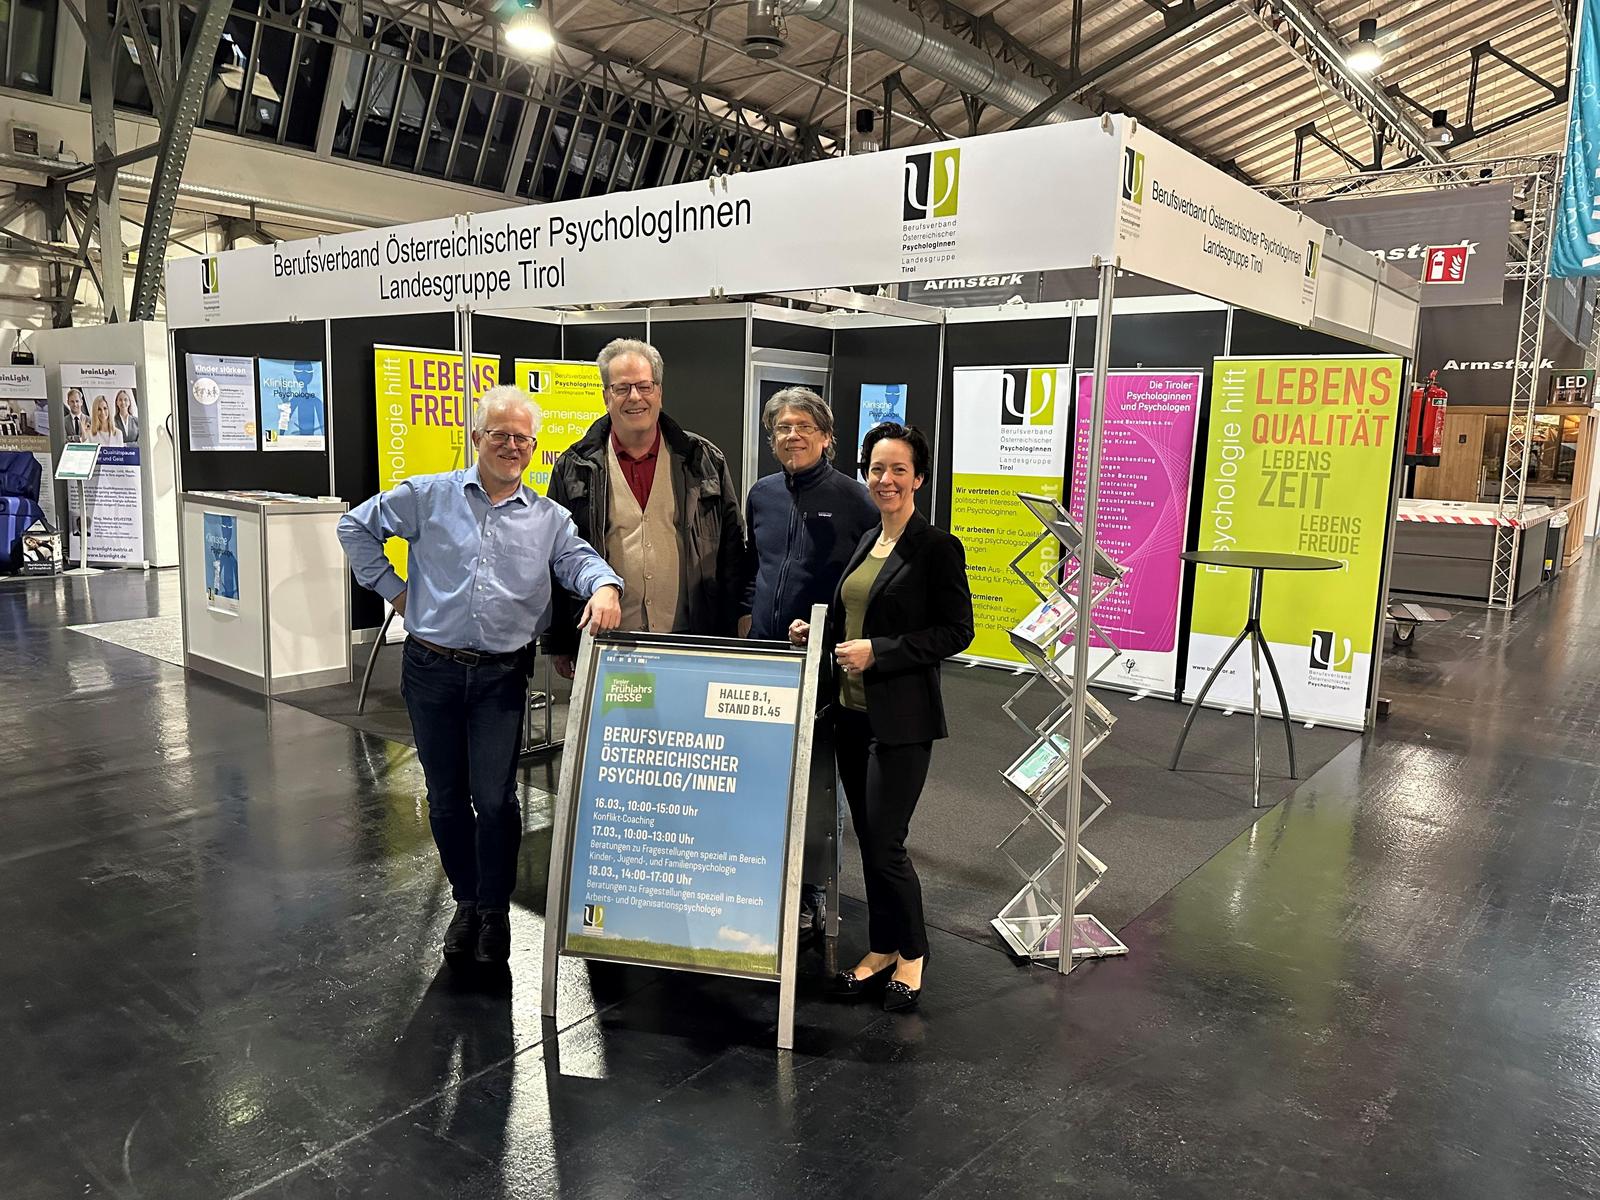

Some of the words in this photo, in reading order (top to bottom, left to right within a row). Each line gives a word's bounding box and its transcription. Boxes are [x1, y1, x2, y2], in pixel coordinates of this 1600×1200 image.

[903, 220, 957, 232] Berufsverband
[1152, 180, 1207, 223] Berufsverband
[1208, 204, 1260, 246] Österreichischer
[1260, 231, 1301, 265] PsychologInnen
[274, 241, 380, 278] Berufsverband
[385, 223, 541, 267] Österreichischer
[549, 198, 752, 254] PsychologInnen
[902, 230, 956, 241] Österreichischer
[901, 254, 956, 264] Landesgruppe
[1203, 234, 1249, 270] Landesgruppe
[1250, 253, 1264, 274] Tirol
[379, 268, 511, 302] Landesgruppe
[519, 258, 566, 290] Tirol
[923, 273, 1024, 291] Armstark
[80, 368, 116, 377] brainLight
[195, 364, 219, 373] Kinder
[1443, 358, 1556, 370] Armstark
[263, 376, 304, 388] Klinische
[384, 357, 401, 396] hilft
[409, 358, 495, 393] LEBENS
[1556, 376, 1588, 389] LED
[273, 389, 316, 398] Psychologie
[1149, 380, 1163, 389] Die
[1165, 380, 1193, 390] Tiroler
[1221, 368, 1247, 413] hilft
[1255, 367, 1393, 406] LEBENS
[1126, 391, 1192, 401] Psychologinnen
[410, 394, 480, 427] FREU
[1120, 403, 1136, 411] und
[1138, 403, 1191, 413] Psychologen
[547, 423, 564, 434] die
[1252, 408, 1390, 447] QUALITÄT
[385, 403, 408, 493] hologie
[1000, 436, 1052, 444] Österreichischer
[1000, 457, 1051, 465] Landesgruppe
[1262, 449, 1332, 471] LEBENS
[1117, 473, 1148, 481] Beratung
[1257, 470, 1331, 510] ZEIT
[955, 497, 988, 505] politischen
[967, 526, 995, 534] arbeiten
[1006, 528, 1017, 536] die
[1300, 514, 1362, 535] LEBENS
[1298, 533, 1361, 555] FREUDE
[971, 593, 1003, 602] formieren
[1308, 670, 1352, 679] Berufsverband
[605, 693, 643, 702] messe
[610, 684, 653, 695] Frühjahrs
[720, 688, 751, 701] HALLE
[752, 691, 771, 704] B.1,
[718, 702, 750, 715] STAND
[752, 705, 781, 717] B1.45
[603, 727, 725, 751] BERUFSVERBAND
[601, 743, 739, 773] ÖSTERREICHISCHER
[598, 767, 737, 793] PSYCHOLOG/INNEN
[594, 797, 625, 812] 16.03.,
[682, 805, 699, 817] Uhr
[593, 812, 655, 828] Konflikt-Coaching
[592, 825, 621, 840] 17.03.,
[678, 833, 695, 845] Uhr
[590, 839, 631, 853] Beratungen
[642, 844, 699, 860] Fragestellungen
[699, 850, 728, 861] speziell
[728, 853, 738, 862] im
[739, 853, 767, 865] Bereich
[588, 865, 618, 880] 18.03.,
[676, 873, 693, 885] Uhr
[649, 858, 664, 866] und
[664, 858, 737, 876] Familienpsychologie
[586, 879, 627, 893] Beratungen
[628, 885, 637, 893] zu
[638, 884, 696, 900] Fragestellungen
[696, 891, 725, 902] speziell
[725, 893, 735, 903] im
[735, 894, 764, 906] Bereich
[585, 892, 614, 903] Arbeits-
[615, 895, 629, 904] und
[630, 896, 722, 916] Organisationspsychologie
